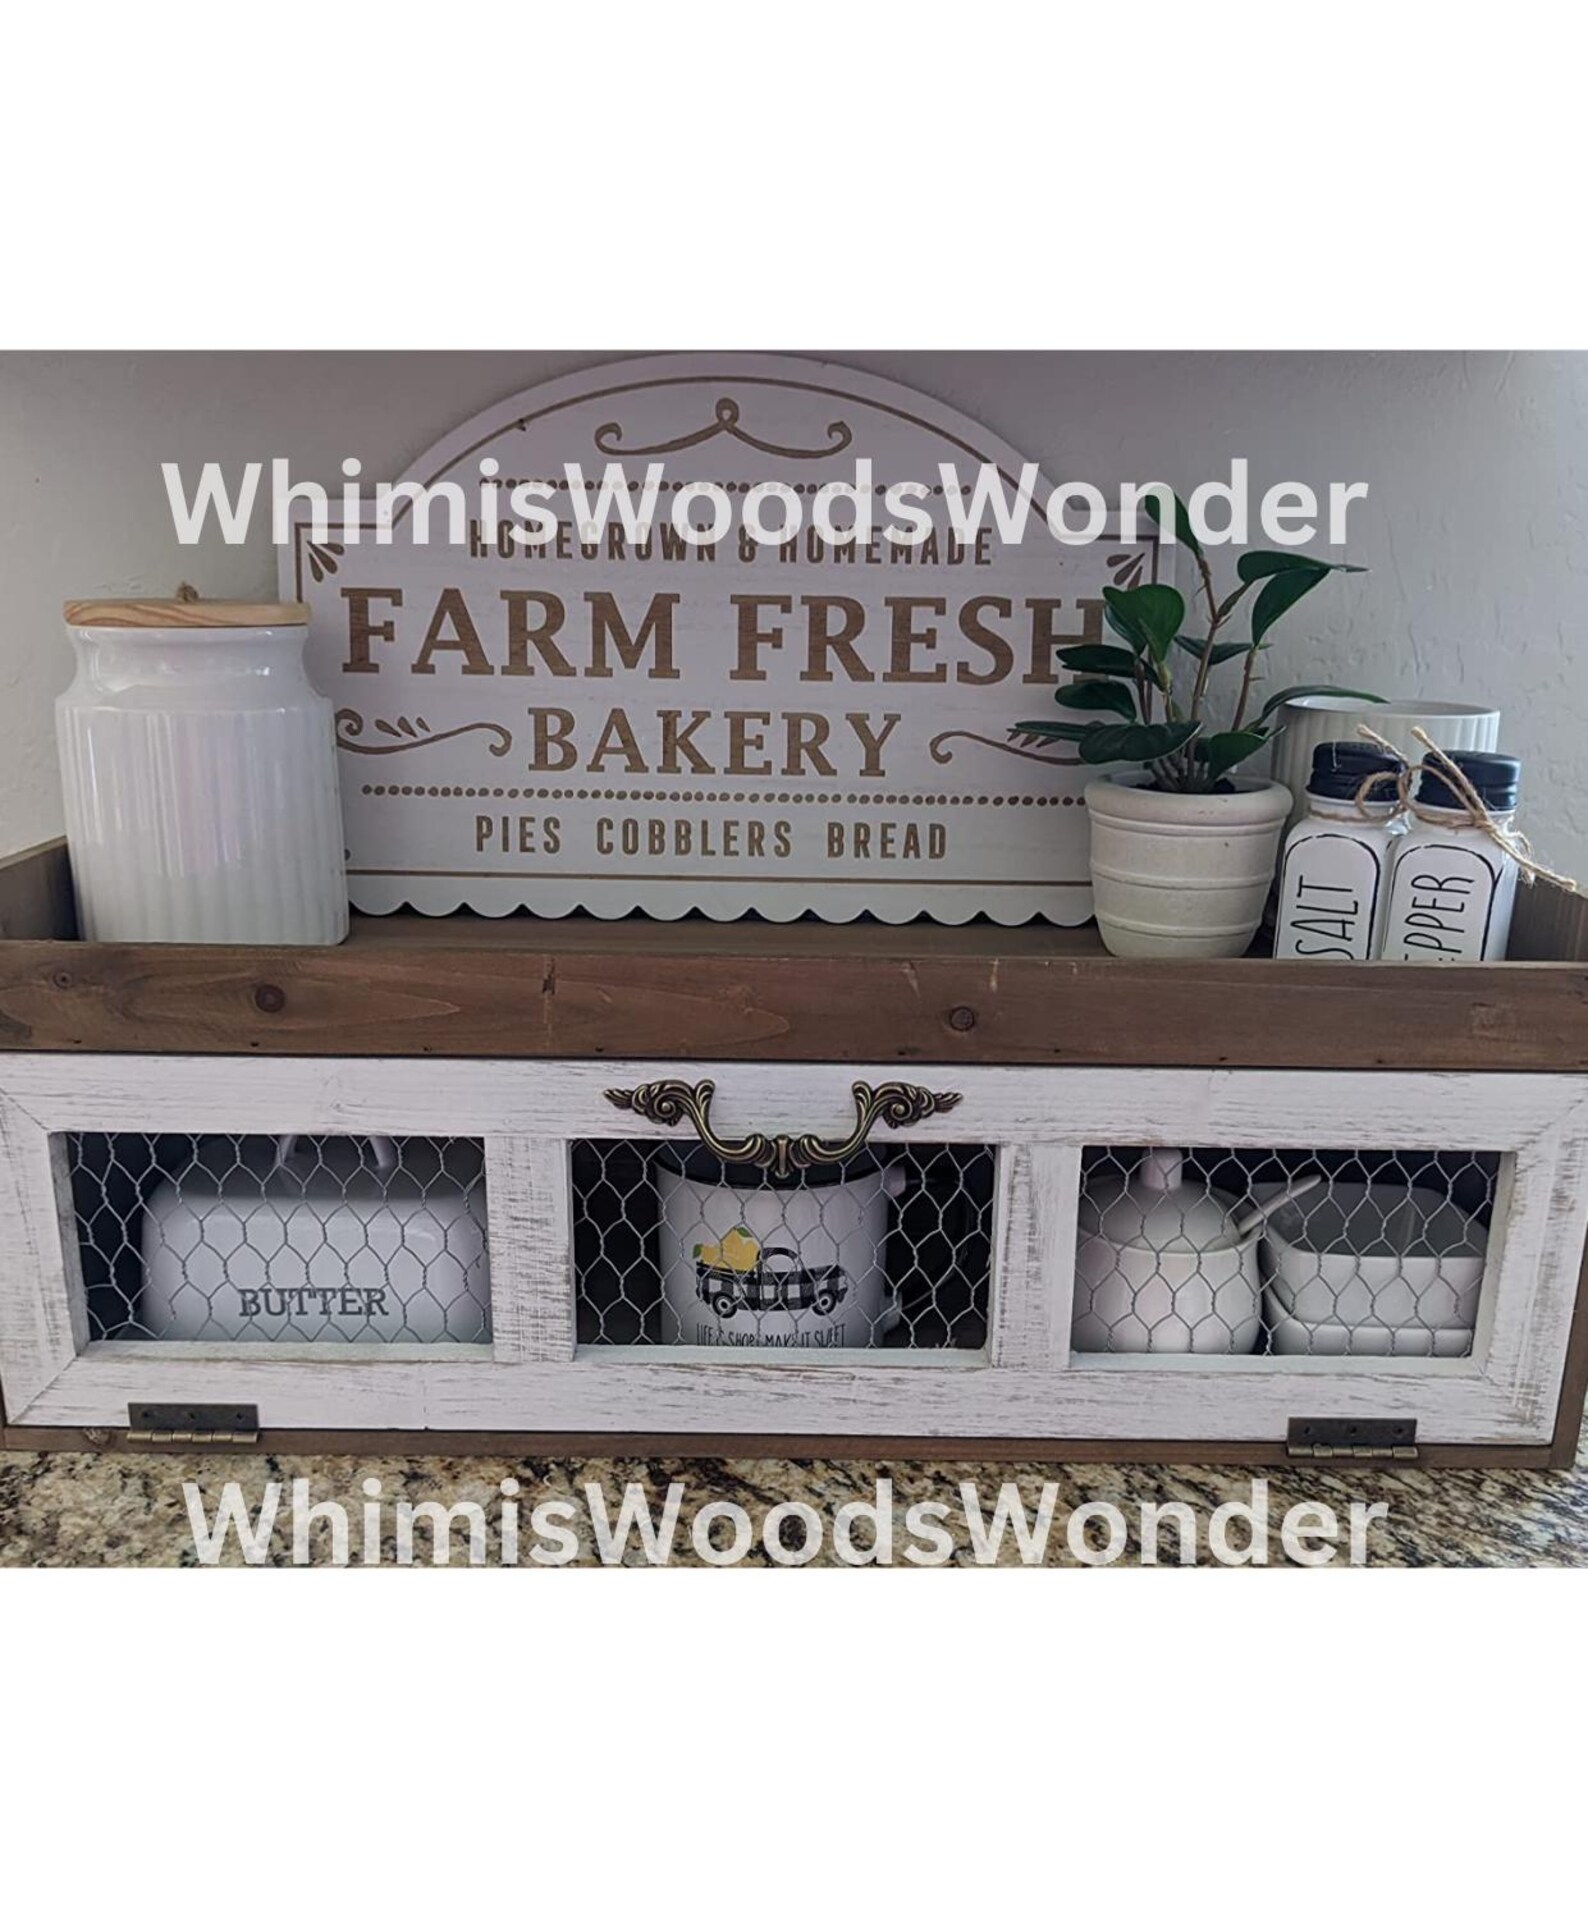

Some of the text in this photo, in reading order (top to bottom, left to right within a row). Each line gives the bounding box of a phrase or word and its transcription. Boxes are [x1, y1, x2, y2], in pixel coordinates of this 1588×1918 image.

[470, 519, 992, 565] HOMEGROWN & HOMEMADE
[340, 587, 1109, 686] FARM FRESH
[528, 706, 902, 778] BAKERY
[476, 814, 948, 860] PIES COBBLERS BREAD
[1290, 874, 1358, 960] SALT
[1402, 873, 1475, 961] PPER
[237, 1286, 389, 1317] BUTTER
